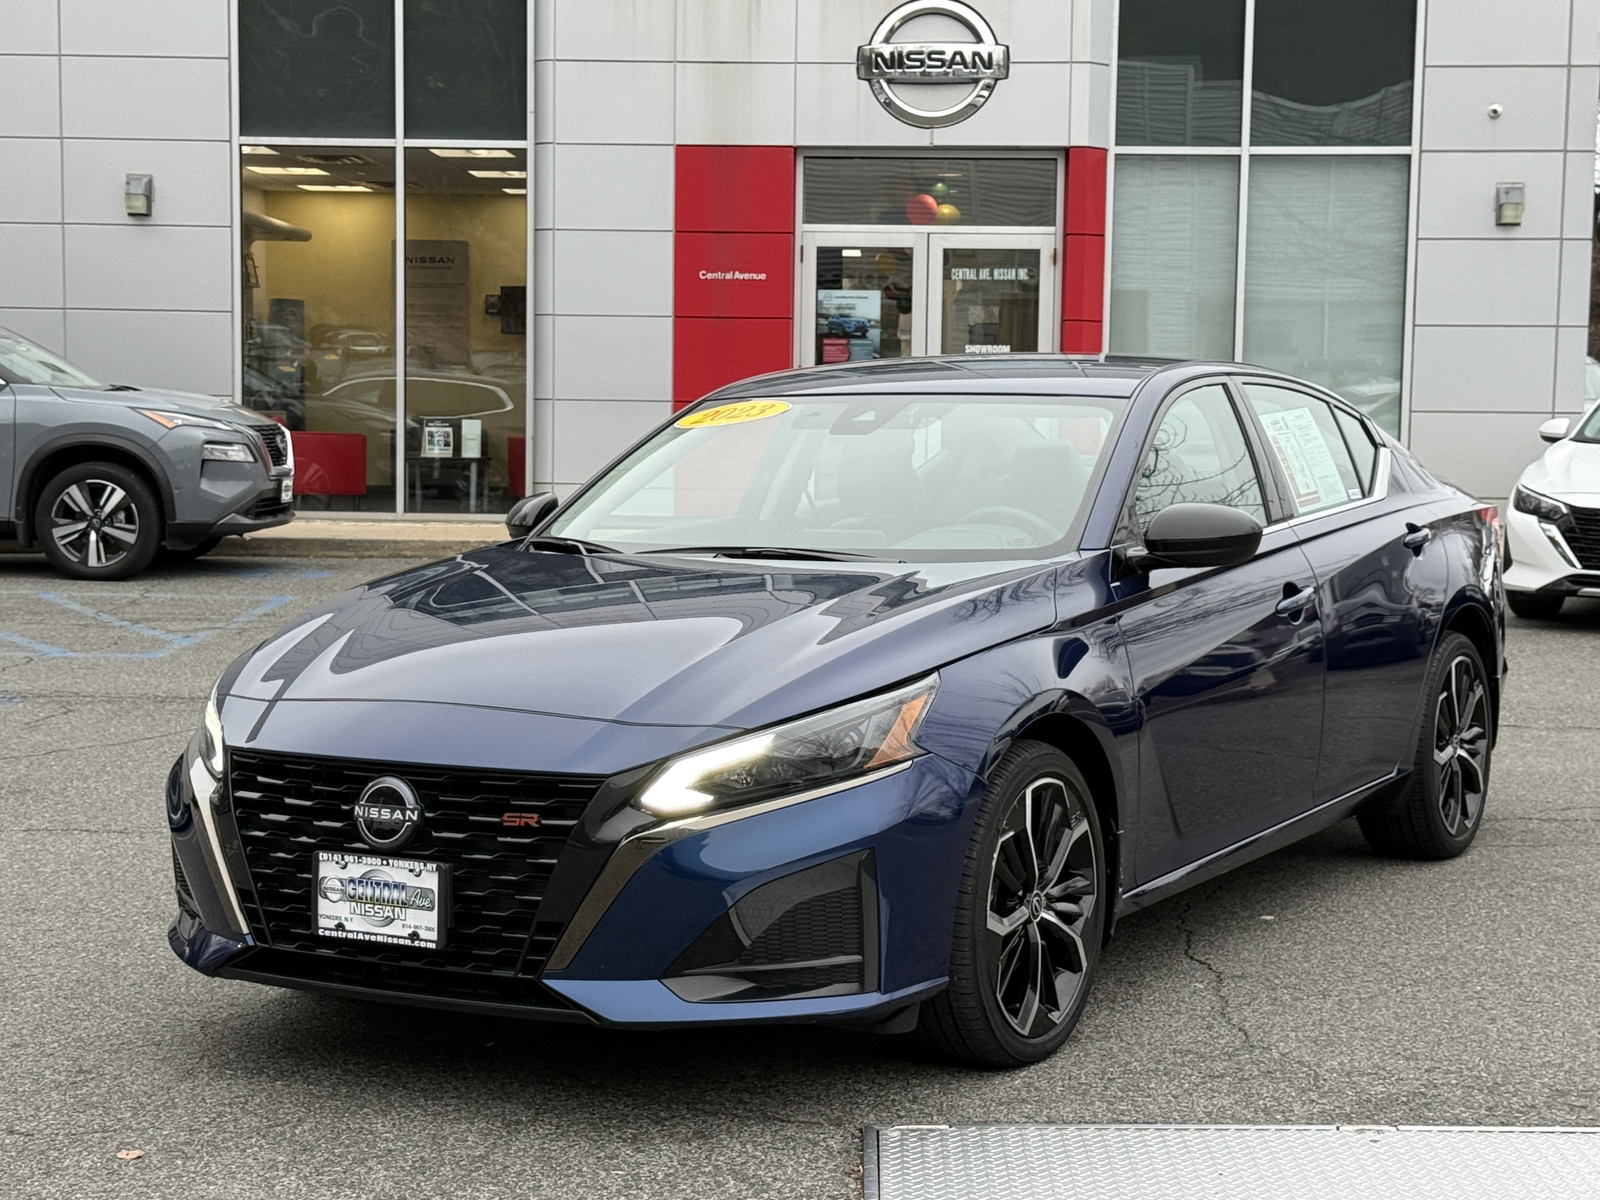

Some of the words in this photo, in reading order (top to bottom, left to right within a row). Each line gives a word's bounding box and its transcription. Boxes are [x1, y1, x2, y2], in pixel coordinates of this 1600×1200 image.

[872, 50, 994, 72] NISSAN
[405, 256, 456, 264] NISSAN
[699, 270, 733, 280] Central
[733, 270, 767, 281] Avenue
[951, 268, 977, 280] CENTRAL
[993, 268, 1016, 280] NISSAN
[964, 344, 1011, 354] SHOWROOM
[689, 403, 776, 426] 2023
[353, 805, 419, 821] NISSAN
[502, 812, 541, 828] SR
[323, 886, 345, 894] NISSAN
[346, 876, 408, 908] CENTRAL
[409, 888, 433, 908] Ave.
[349, 901, 407, 921] NISSAN
[318, 928, 436, 949] CentralAveNissan.com
